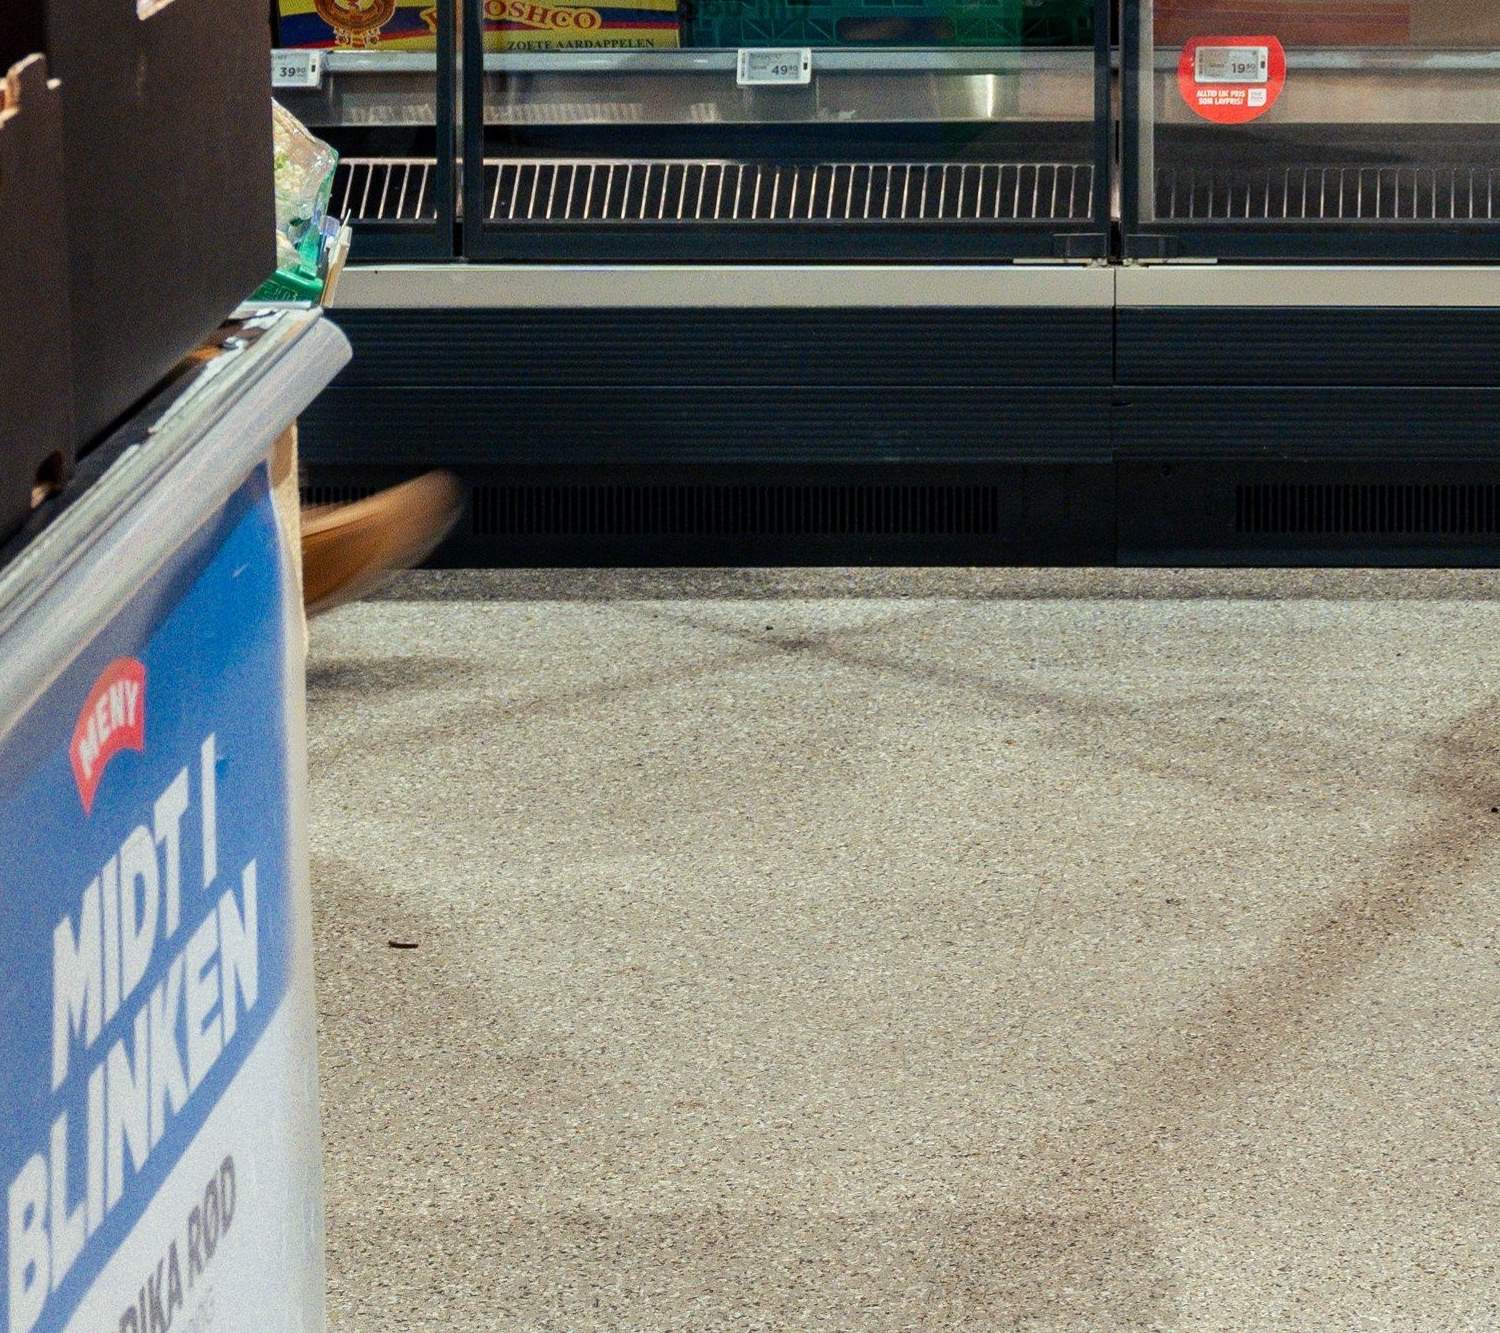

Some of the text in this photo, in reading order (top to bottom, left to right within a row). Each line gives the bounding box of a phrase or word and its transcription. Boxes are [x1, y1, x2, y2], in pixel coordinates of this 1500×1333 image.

[506, 36, 655, 50] ZOETE AARDAPPELEN
[78, 679, 143, 776] MENY
[50, 761, 191, 1093] MIDT
[6, 860, 260, 1333] BLINKEN
[186, 1154, 237, 1288] RØD
